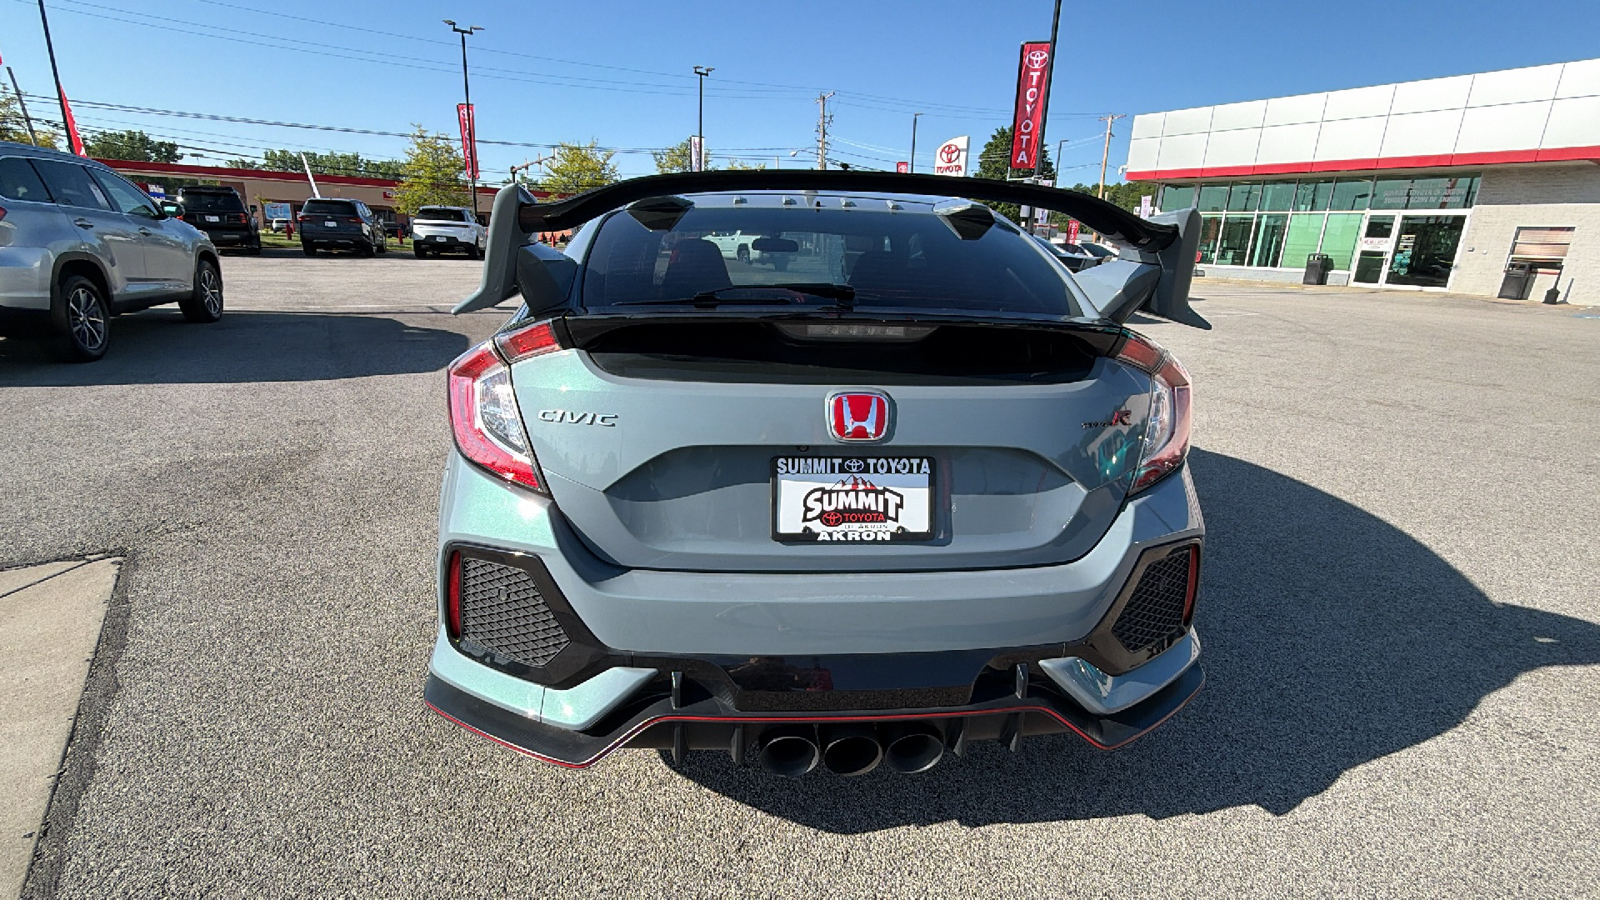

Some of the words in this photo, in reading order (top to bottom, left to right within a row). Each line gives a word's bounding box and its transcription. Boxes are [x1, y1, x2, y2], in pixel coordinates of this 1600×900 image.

[1016, 71, 1041, 164] TOYOTA
[936, 164, 962, 174] TOYOTA
[538, 409, 619, 427] CIVIC
[776, 458, 843, 474] SUMMIT
[866, 458, 931, 474] TOYOTA
[803, 488, 904, 522] SUMMIT
[843, 513, 886, 523] TOYOTA
[817, 531, 891, 541] AKRON
